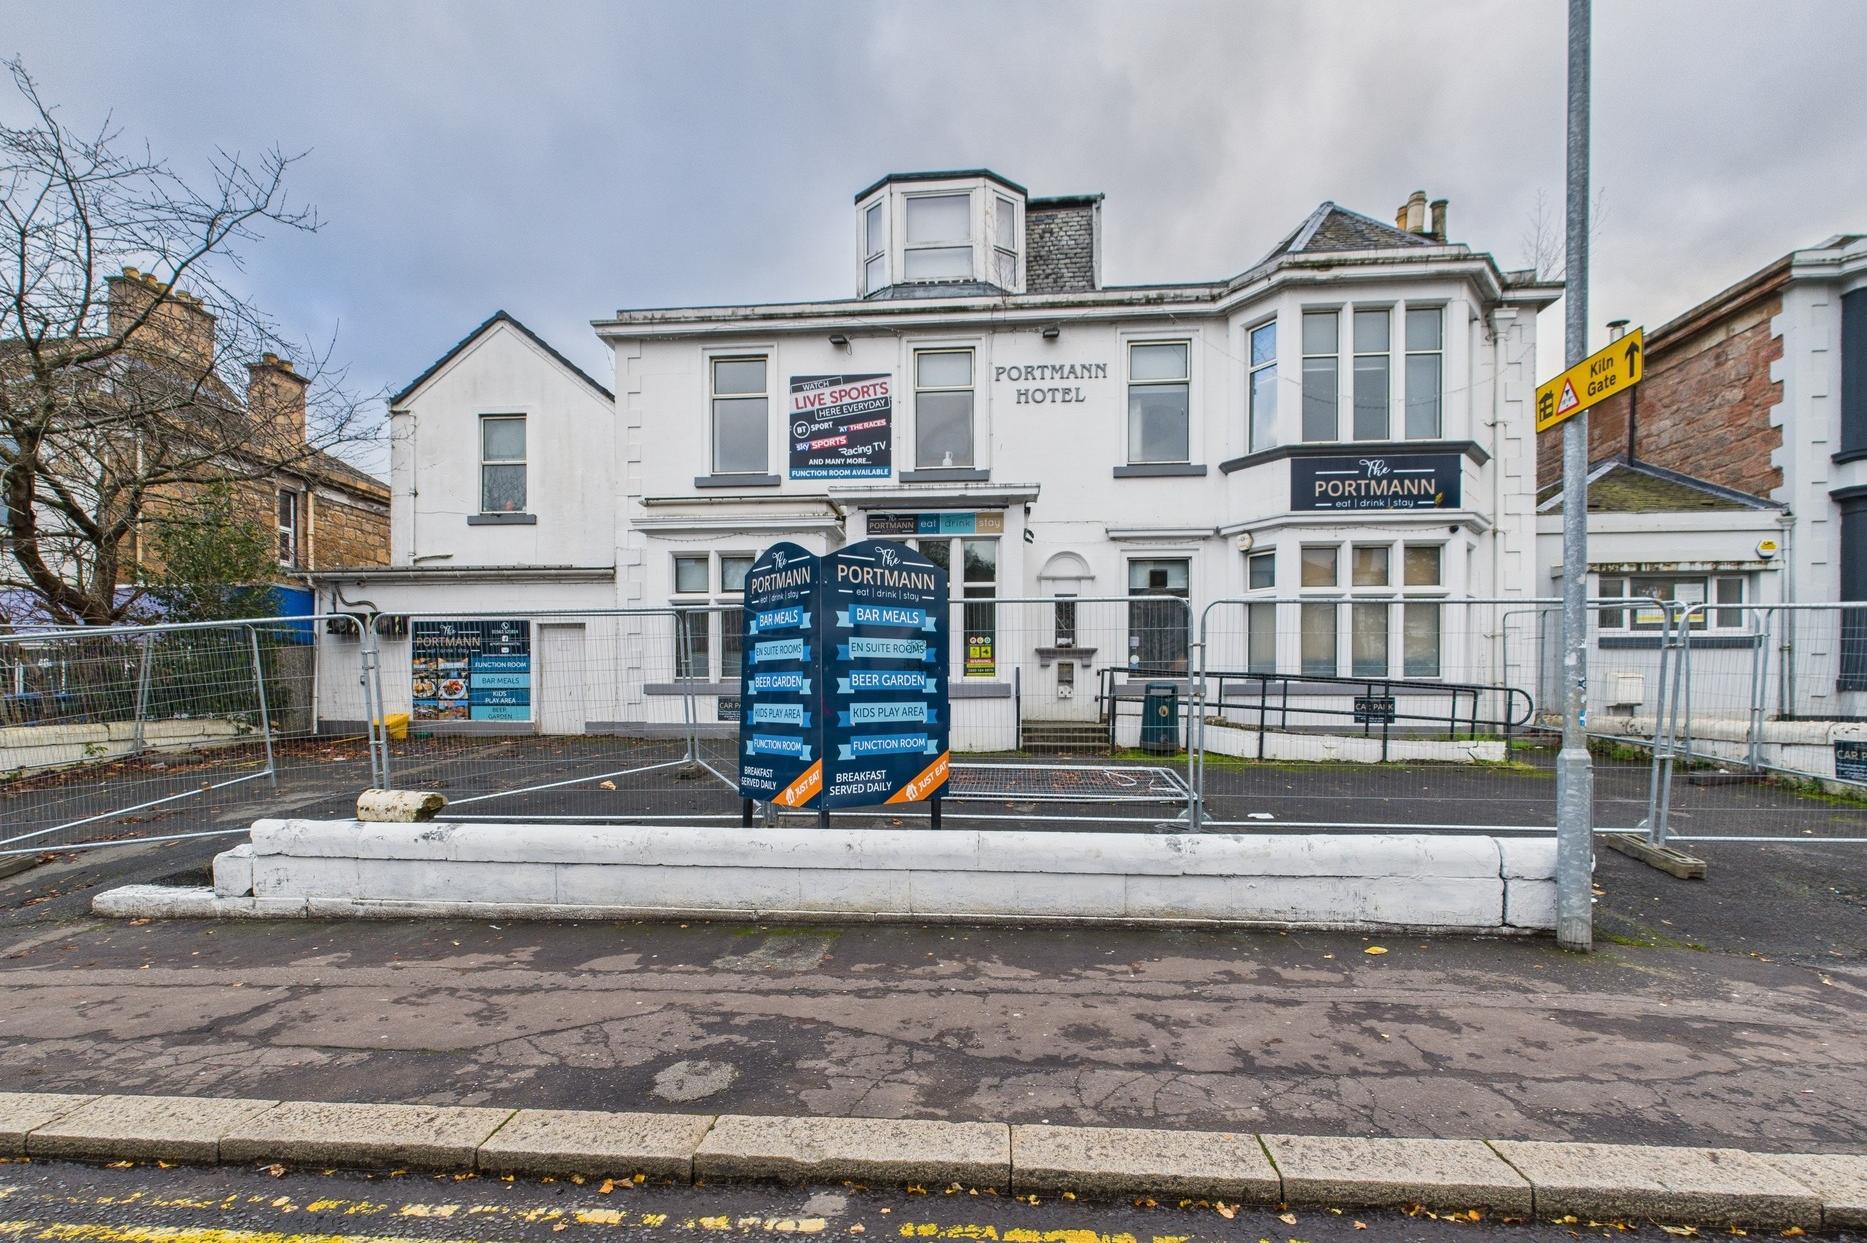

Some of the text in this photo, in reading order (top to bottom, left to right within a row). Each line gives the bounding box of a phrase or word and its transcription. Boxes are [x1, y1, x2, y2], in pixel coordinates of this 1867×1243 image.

[994, 363, 1108, 382] PORTMANN
[1590, 357, 1614, 378] Kiln
[802, 380, 830, 392] WATCH
[1587, 374, 1616, 396] Gate
[794, 382, 889, 410] LIVE SPORTS
[1016, 387, 1086, 404] HOTEL
[819, 398, 886, 418] HERE EVERYDAY
[796, 421, 833, 434] BT SPORT
[864, 418, 886, 430] RACES
[811, 436, 848, 450] SPORTS
[838, 441, 886, 456] Racing TV
[1359, 459, 1390, 478] The
[1314, 478, 1436, 497] PORTMANN
[1336, 498, 1414, 508] eat drink stay
[869, 521, 914, 530] PORTMANN
[944, 518, 970, 528] drink
[980, 518, 1000, 529] stay
[772, 550, 788, 570] The
[874, 546, 900, 567] The
[752, 566, 810, 594] PORTMANN
[837, 564, 934, 590] PORTMANN
[771, 593, 784, 602] drink
[788, 590, 798, 600] stay
[856, 588, 919, 602] eat drink stay
[760, 610, 798, 626] BAR MEALS
[856, 608, 919, 624] BAR MEALS
[416, 636, 480, 646] PORTMANN
[852, 642, 924, 654] EN SUITE ROOMS
[756, 644, 802, 656] EN SUITE ROOMS
[756, 676, 802, 688] BEER GARDEN
[852, 674, 924, 686] BEER GARDEN
[755, 708, 800, 718] KIDS PLAY AREA
[853, 706, 924, 718] KIDS PLAY AREA
[754, 739, 801, 751] FUNCTION ROOM
[854, 738, 926, 750] FUNCTION ROOM
[1836, 750, 1858, 760] CAR
[744, 766, 773, 778] BREAKFAST
[836, 770, 886, 782] BREAKFAST
[918, 760, 947, 791] JUST EAT
[742, 776, 776, 790] SERVED DAILY
[795, 770, 820, 798] JUST EAT
[830, 782, 892, 796] SERVED DAILY
